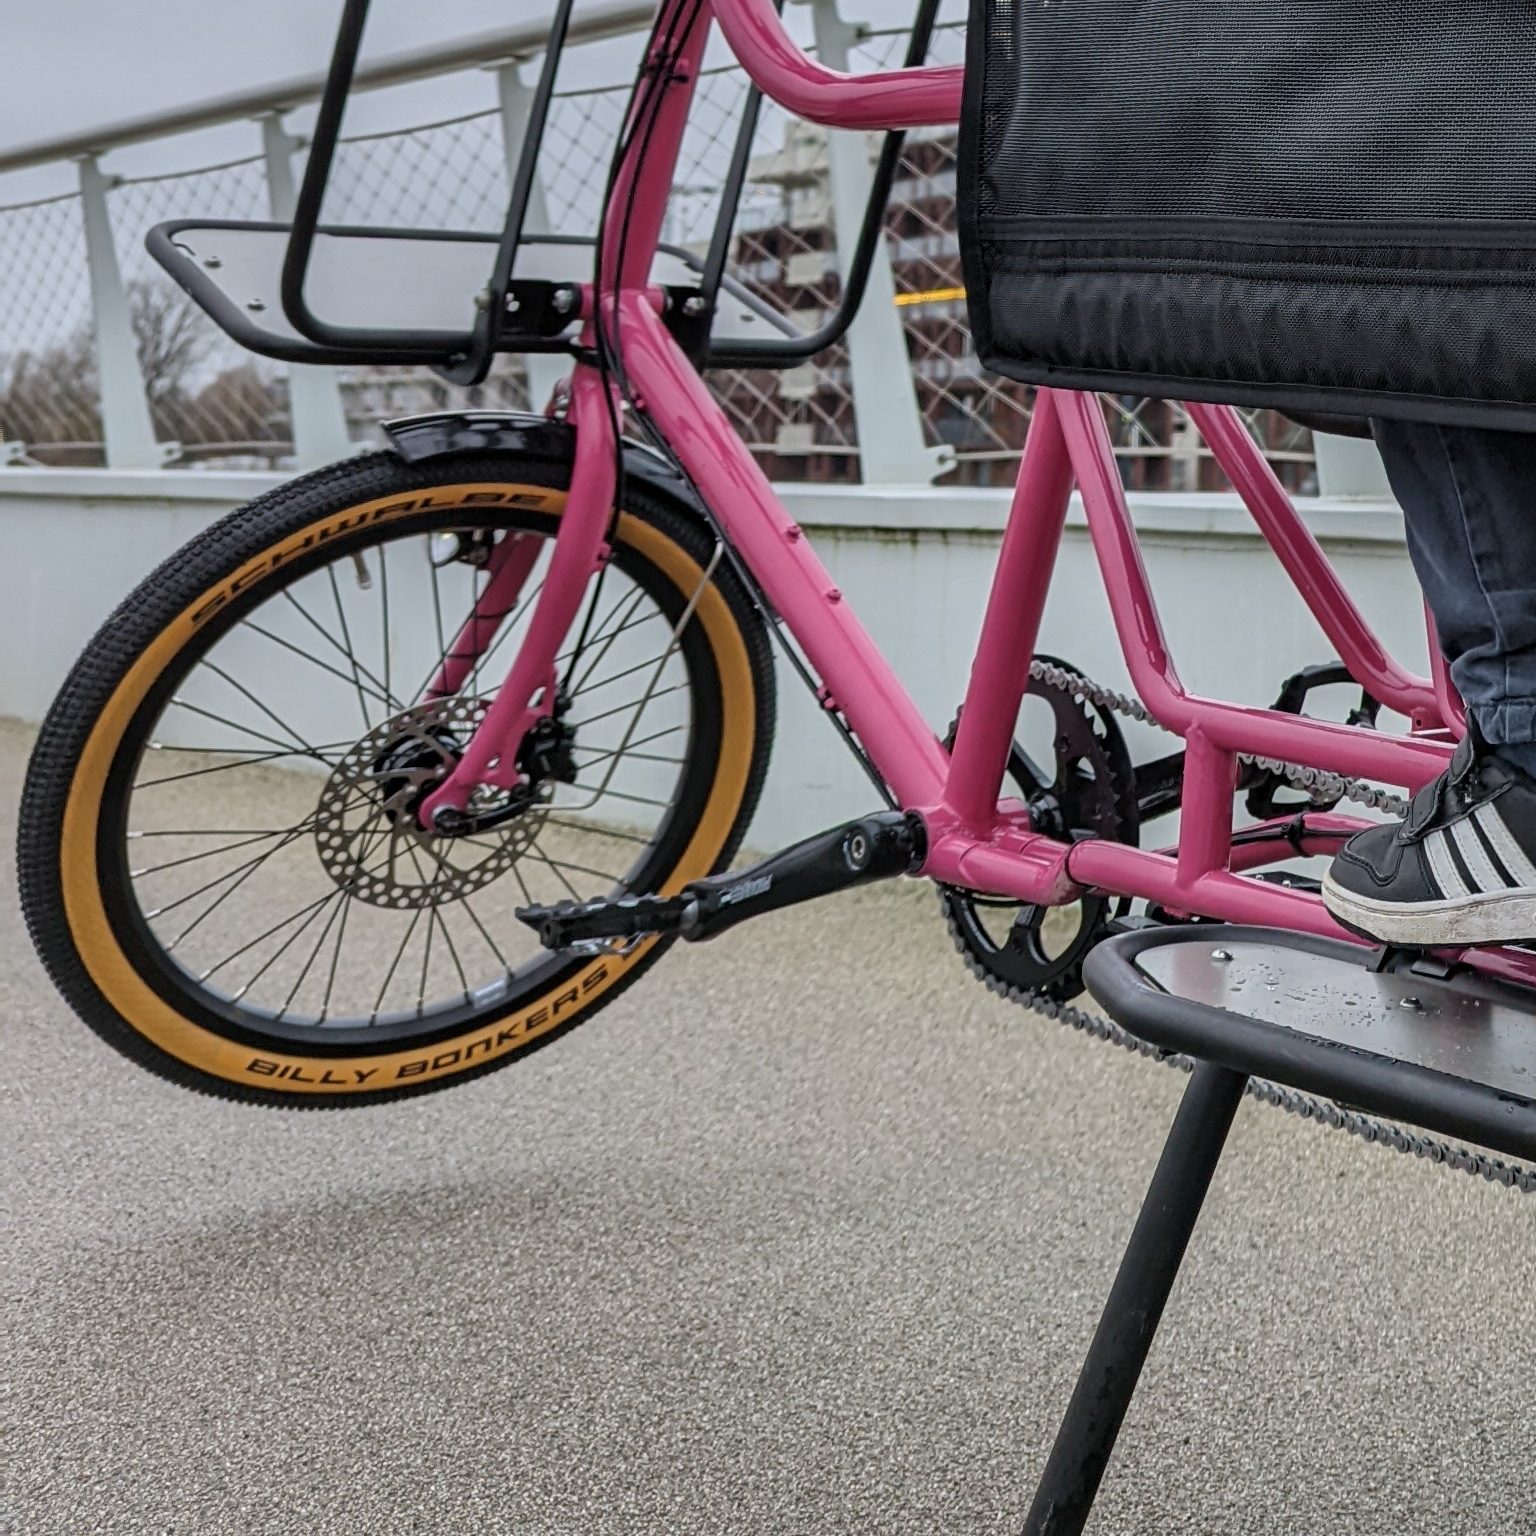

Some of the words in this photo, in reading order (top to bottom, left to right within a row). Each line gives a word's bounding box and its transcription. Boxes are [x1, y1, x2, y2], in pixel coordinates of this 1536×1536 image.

[191, 492, 547, 627] SCHWALBE
[245, 1058, 378, 1085] BILLY
[395, 963, 609, 1080] BONKERS
